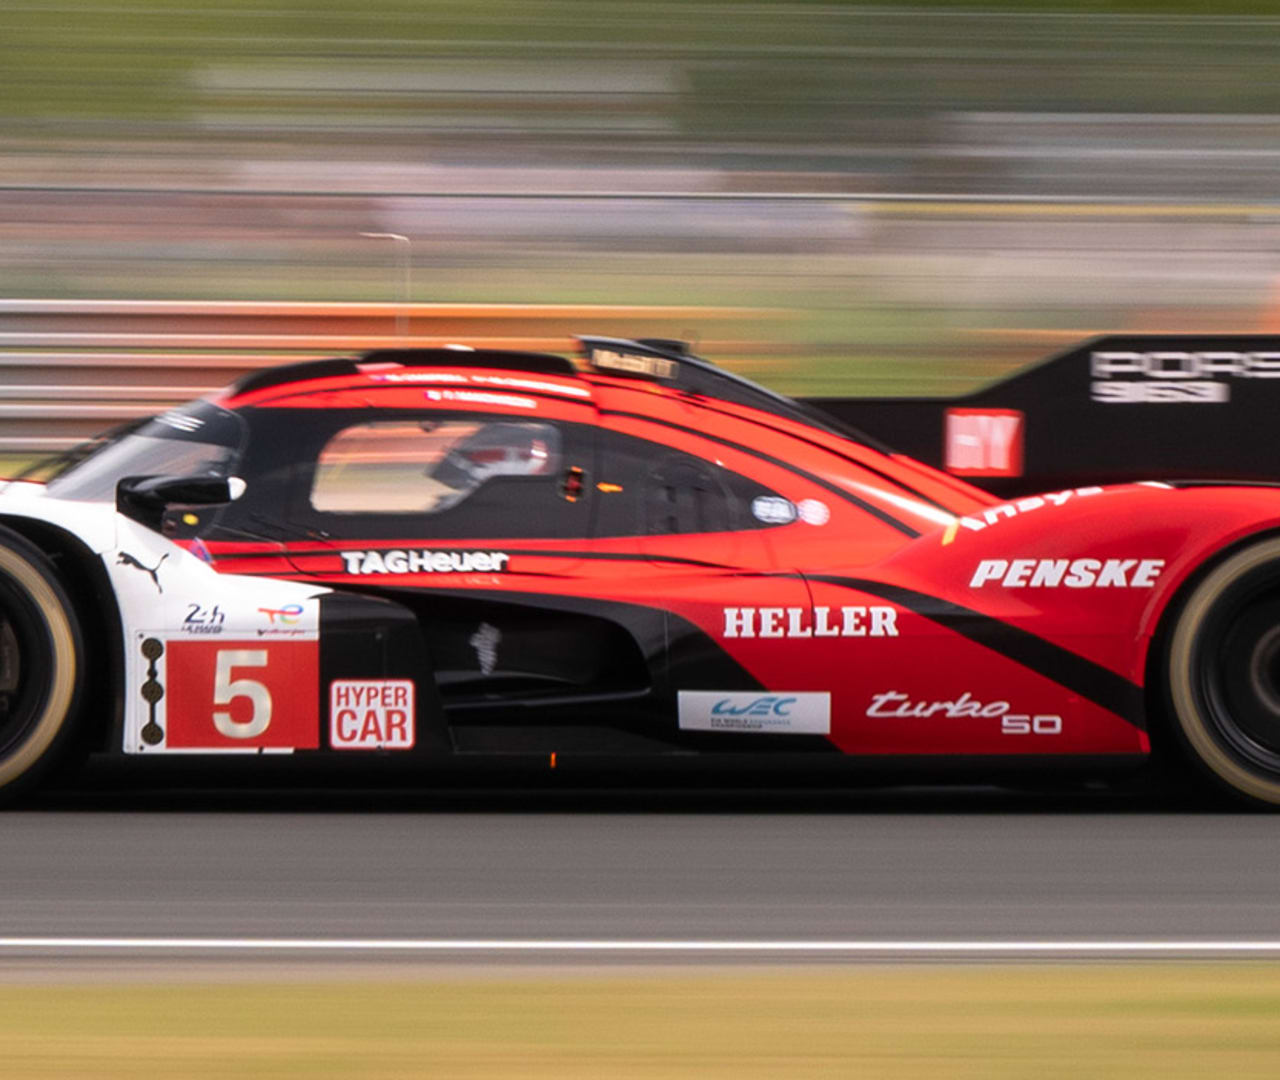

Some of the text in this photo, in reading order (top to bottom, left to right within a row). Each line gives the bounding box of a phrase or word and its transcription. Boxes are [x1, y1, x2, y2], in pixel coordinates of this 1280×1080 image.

[970, 559, 1165, 588] PENSKE
[723, 607, 899, 638] HELLER
[212, 649, 273, 739] 5
[336, 686, 408, 708] HYPER
[711, 697, 798, 716] WEC
[866, 691, 1011, 718] turbo
[336, 711, 408, 742] CAR
[1001, 715, 1062, 735] 50
